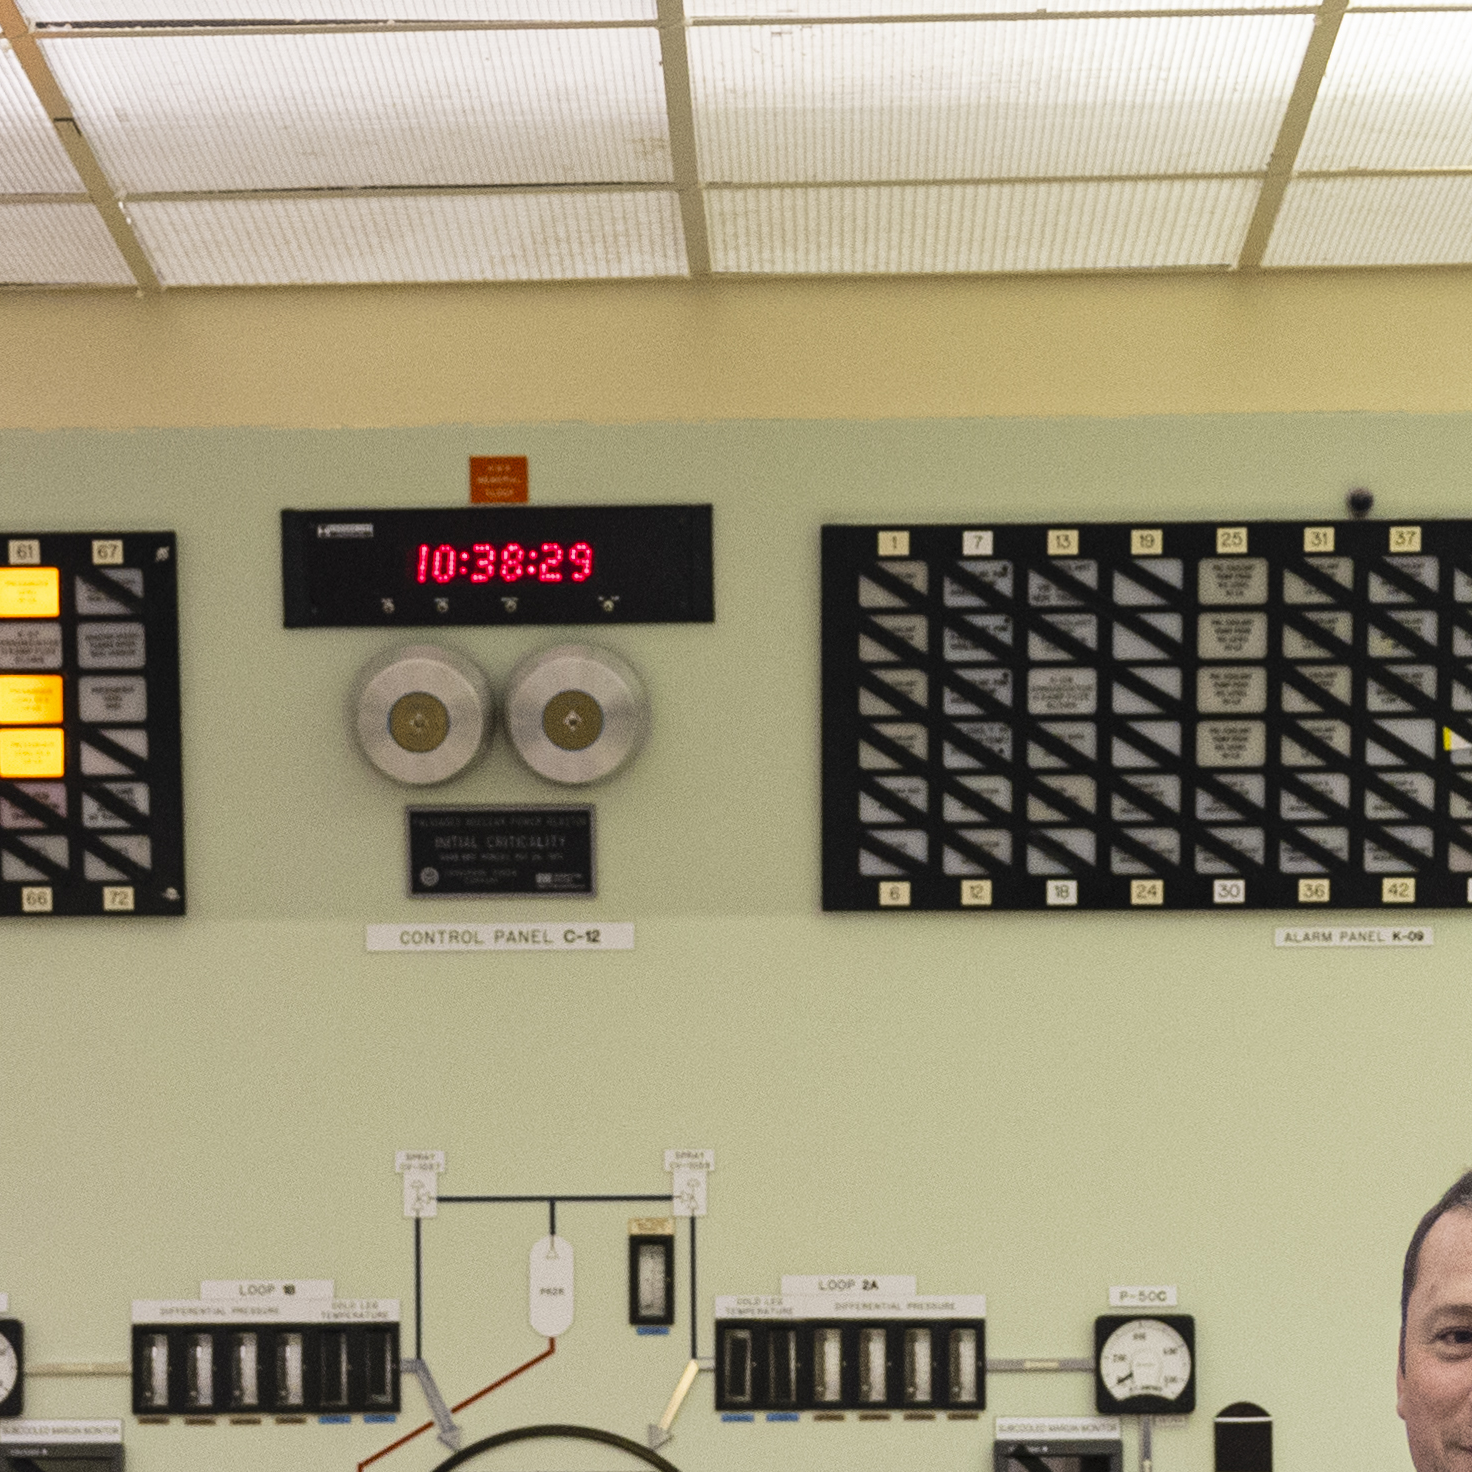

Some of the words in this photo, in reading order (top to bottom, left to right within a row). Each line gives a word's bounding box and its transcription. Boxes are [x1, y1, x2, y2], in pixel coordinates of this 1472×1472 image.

[1221, 533, 1242, 547] 25
[1395, 531, 1416, 545] 37
[98, 545, 118, 559] 67
[416, 543, 593, 583] 10:38:29
[1389, 883, 1408, 897] 42
[400, 930, 484, 944] CONTROL
[494, 930, 553, 944] PANEL
[563, 930, 600, 943] C-12
[1285, 932, 1332, 942] ALARM
[1339, 931, 1385, 942] PANEL
[818, 1280, 855, 1291] LOOP
[862, 1280, 878, 1291] 2A
[1119, 1290, 1166, 1303] P-50C
